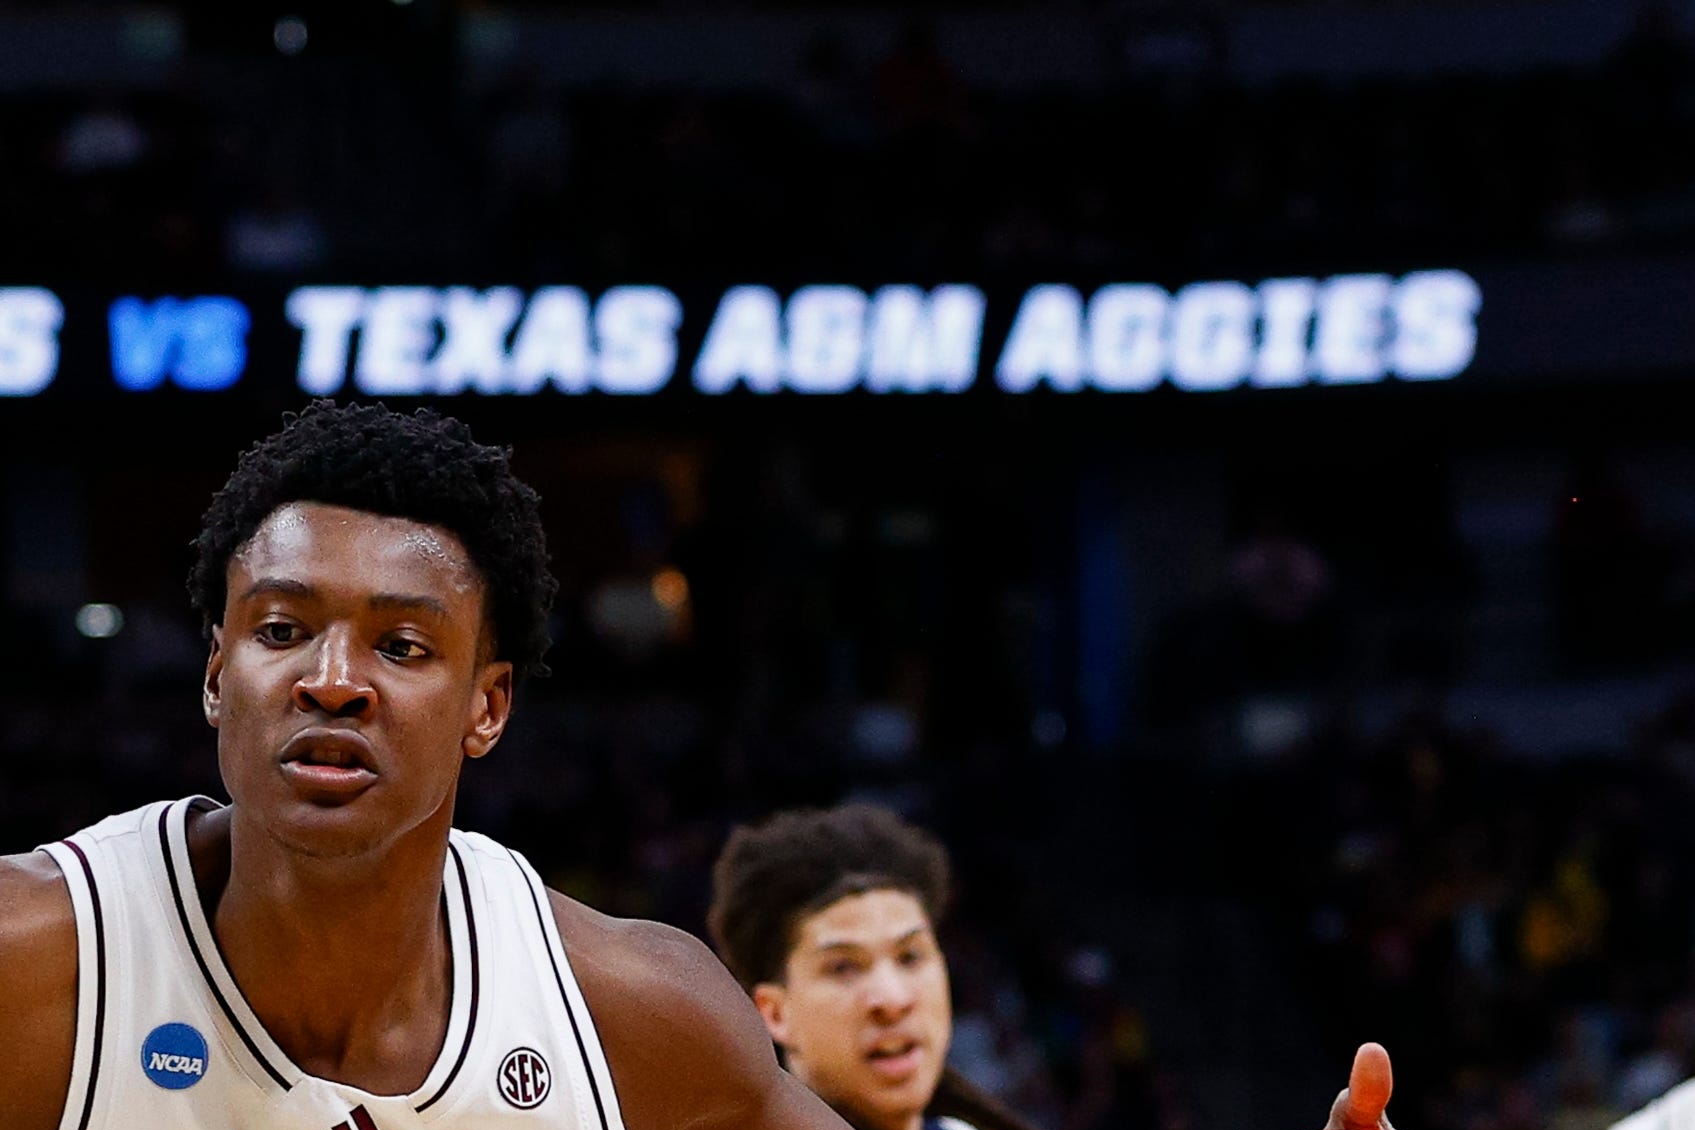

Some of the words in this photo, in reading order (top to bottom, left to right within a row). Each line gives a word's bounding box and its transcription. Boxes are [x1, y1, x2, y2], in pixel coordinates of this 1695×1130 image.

[108, 296, 250, 391] VS
[286, 285, 682, 395] TEXAS
[995, 270, 1482, 393] AGGIES
[149, 1052, 203, 1075] NCAA
[503, 1053, 546, 1103] SEC
